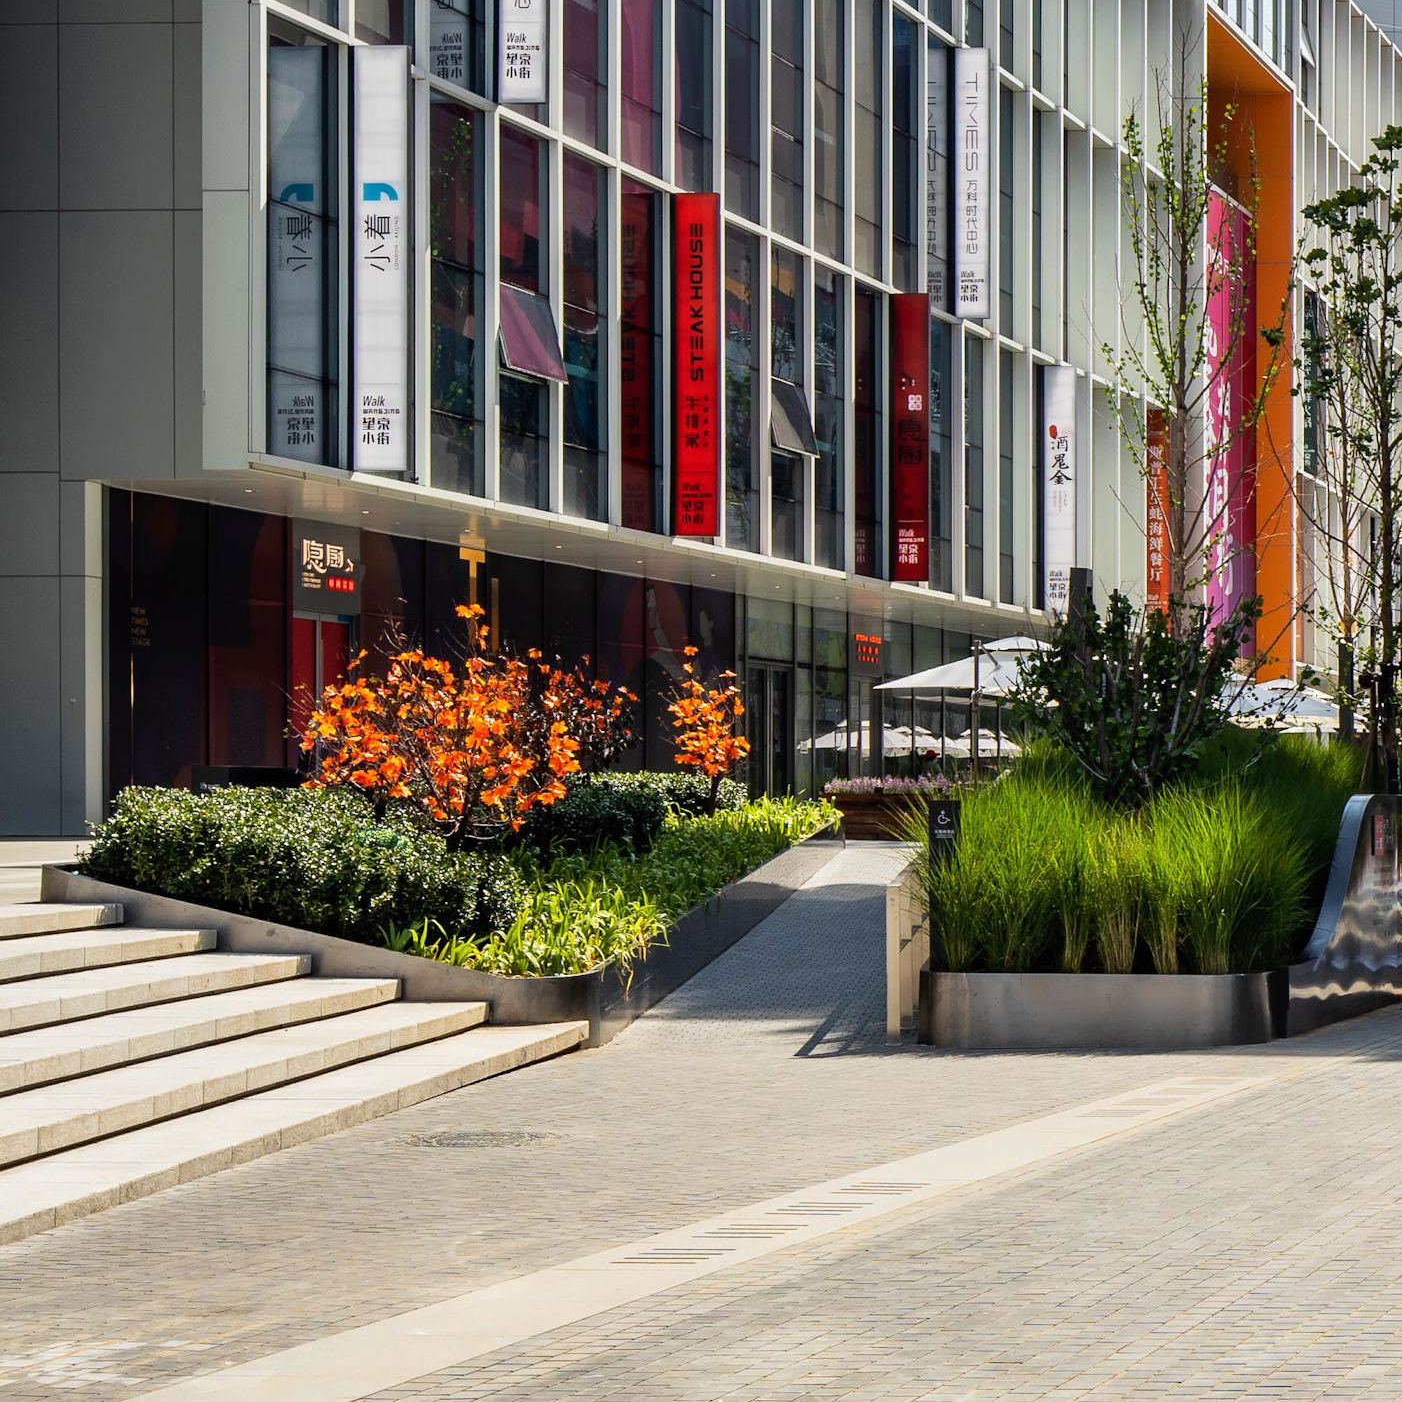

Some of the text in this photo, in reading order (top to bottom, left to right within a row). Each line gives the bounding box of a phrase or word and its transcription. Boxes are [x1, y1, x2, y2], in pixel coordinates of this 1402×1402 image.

[506, 32, 527, 44] Walk
[506, 52, 531, 66] 望京
[506, 66, 531, 79] 小街
[965, 72, 978, 172] TIMES
[965, 179, 978, 255] 万科时代中心
[689, 223, 704, 382] STEAK HOUSE
[362, 395, 386, 407] Walk
[362, 417, 391, 431] 望京
[362, 431, 391, 445] 小街
